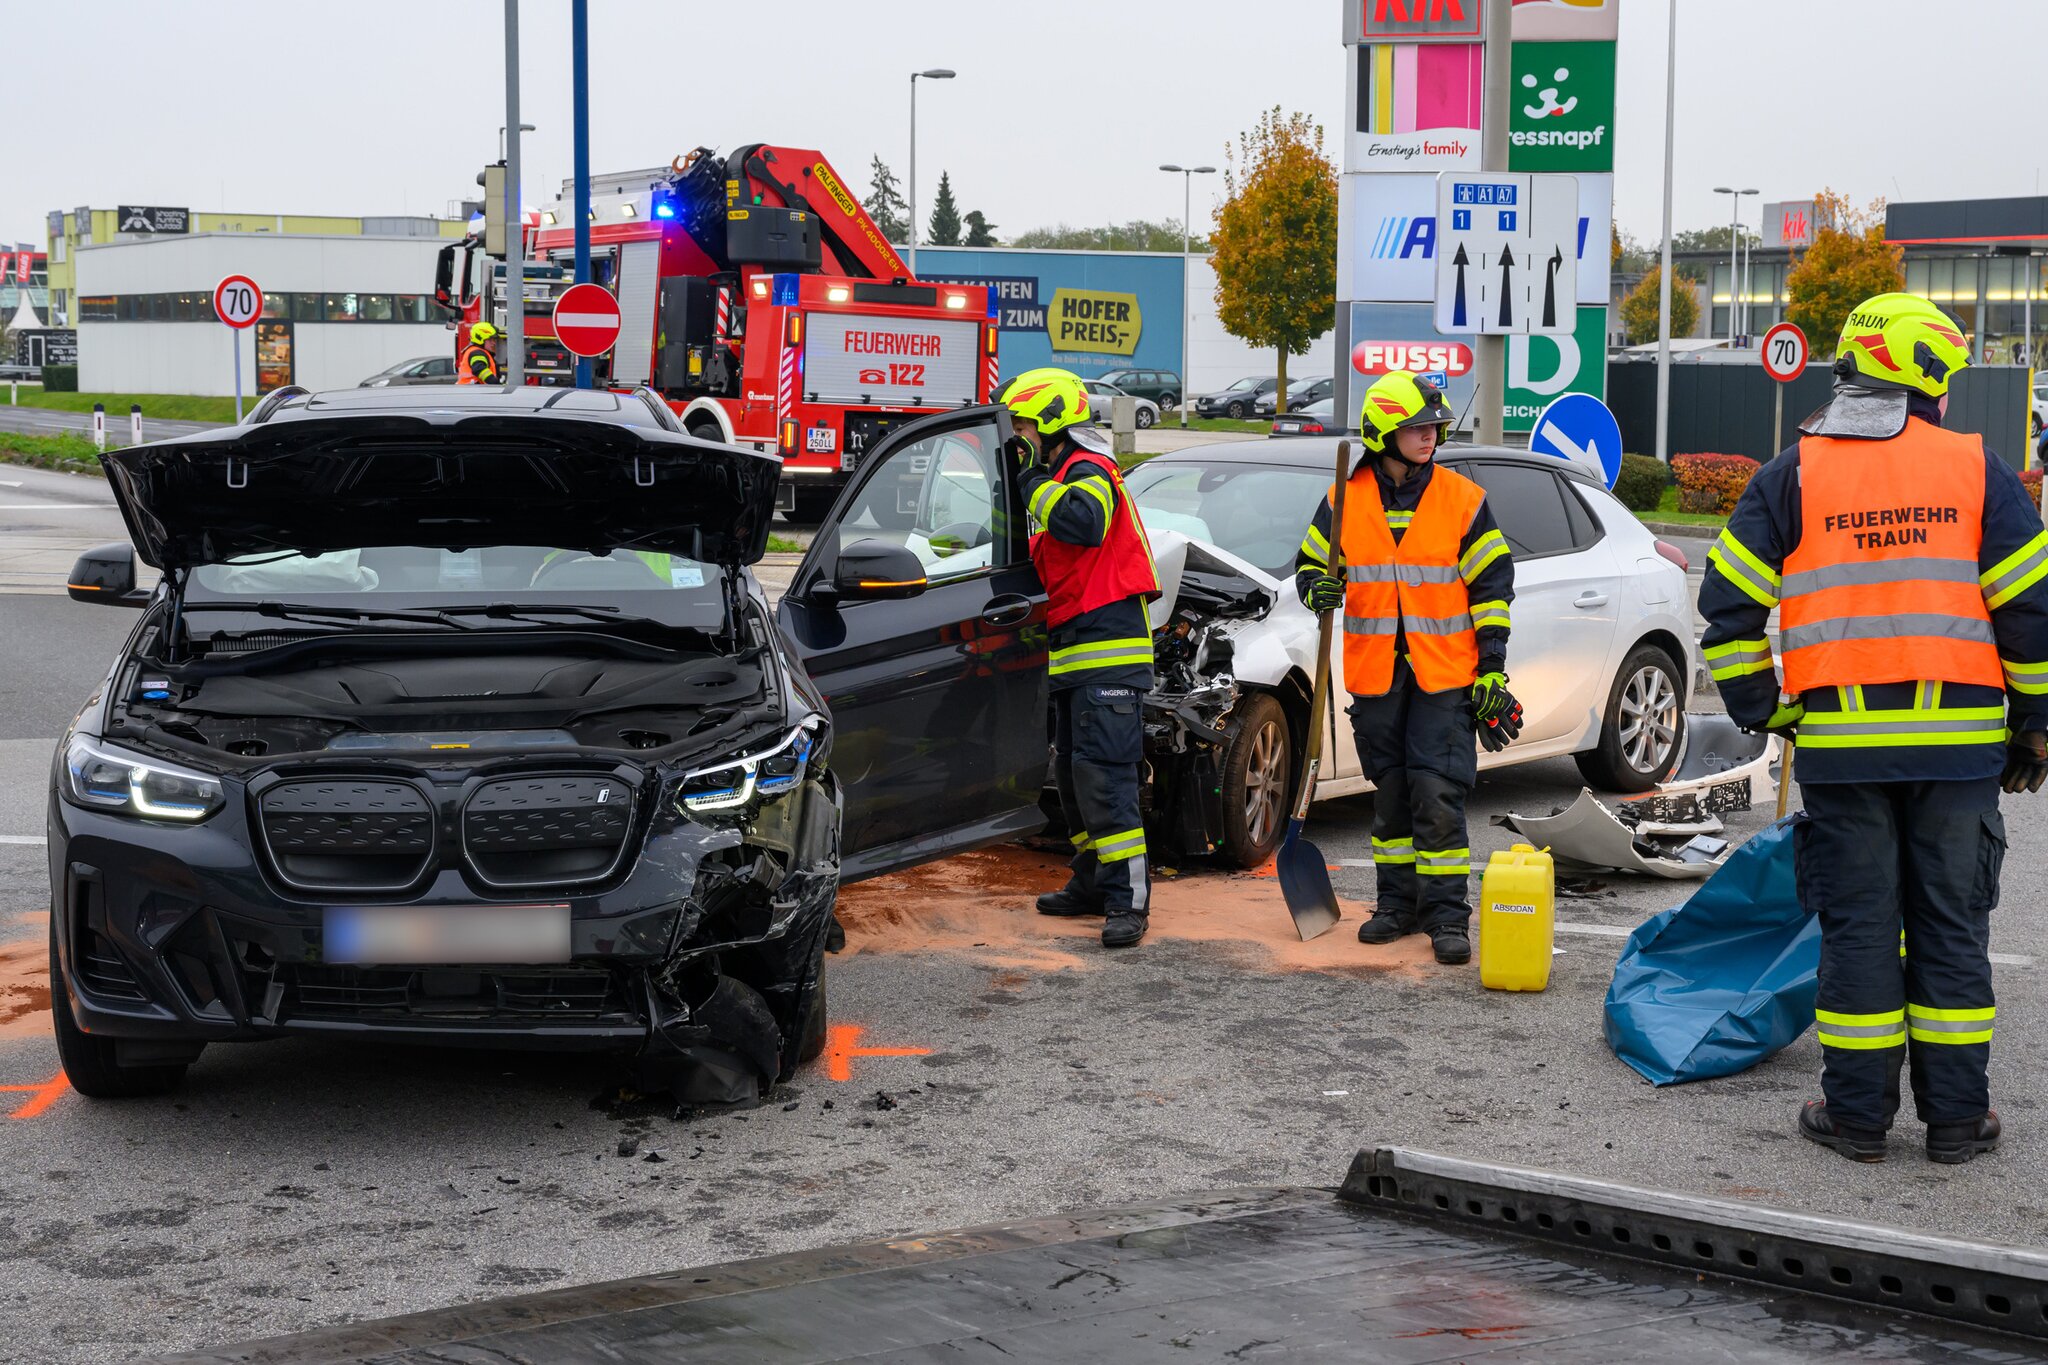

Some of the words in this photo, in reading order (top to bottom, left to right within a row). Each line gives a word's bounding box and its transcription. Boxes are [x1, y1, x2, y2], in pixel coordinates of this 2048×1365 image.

[1368, 143, 1420, 160] Ernsting's
[1423, 140, 1468, 158] family
[816, 165, 854, 214] PALFINGER
[1480, 187, 1493, 201] A1
[1498, 188, 1511, 202] A7
[856, 217, 869, 232] PK
[1458, 212, 1464, 228] 1
[1503, 213, 1510, 229] 1
[226, 288, 252, 316] 70
[1062, 298, 1130, 322] HOFER
[1006, 309, 1044, 327] ZUM
[844, 330, 941, 357] FEUERWEHR
[1775, 340, 1796, 365] 70
[1364, 347, 1465, 372] FUSSL
[888, 363, 925, 386] 122
[816, 430, 826, 438] FW
[1825, 507, 1958, 532] FEUERWEHR
[1854, 528, 1927, 550] TRAUN
[1494, 903, 1534, 913] ABSODAN
